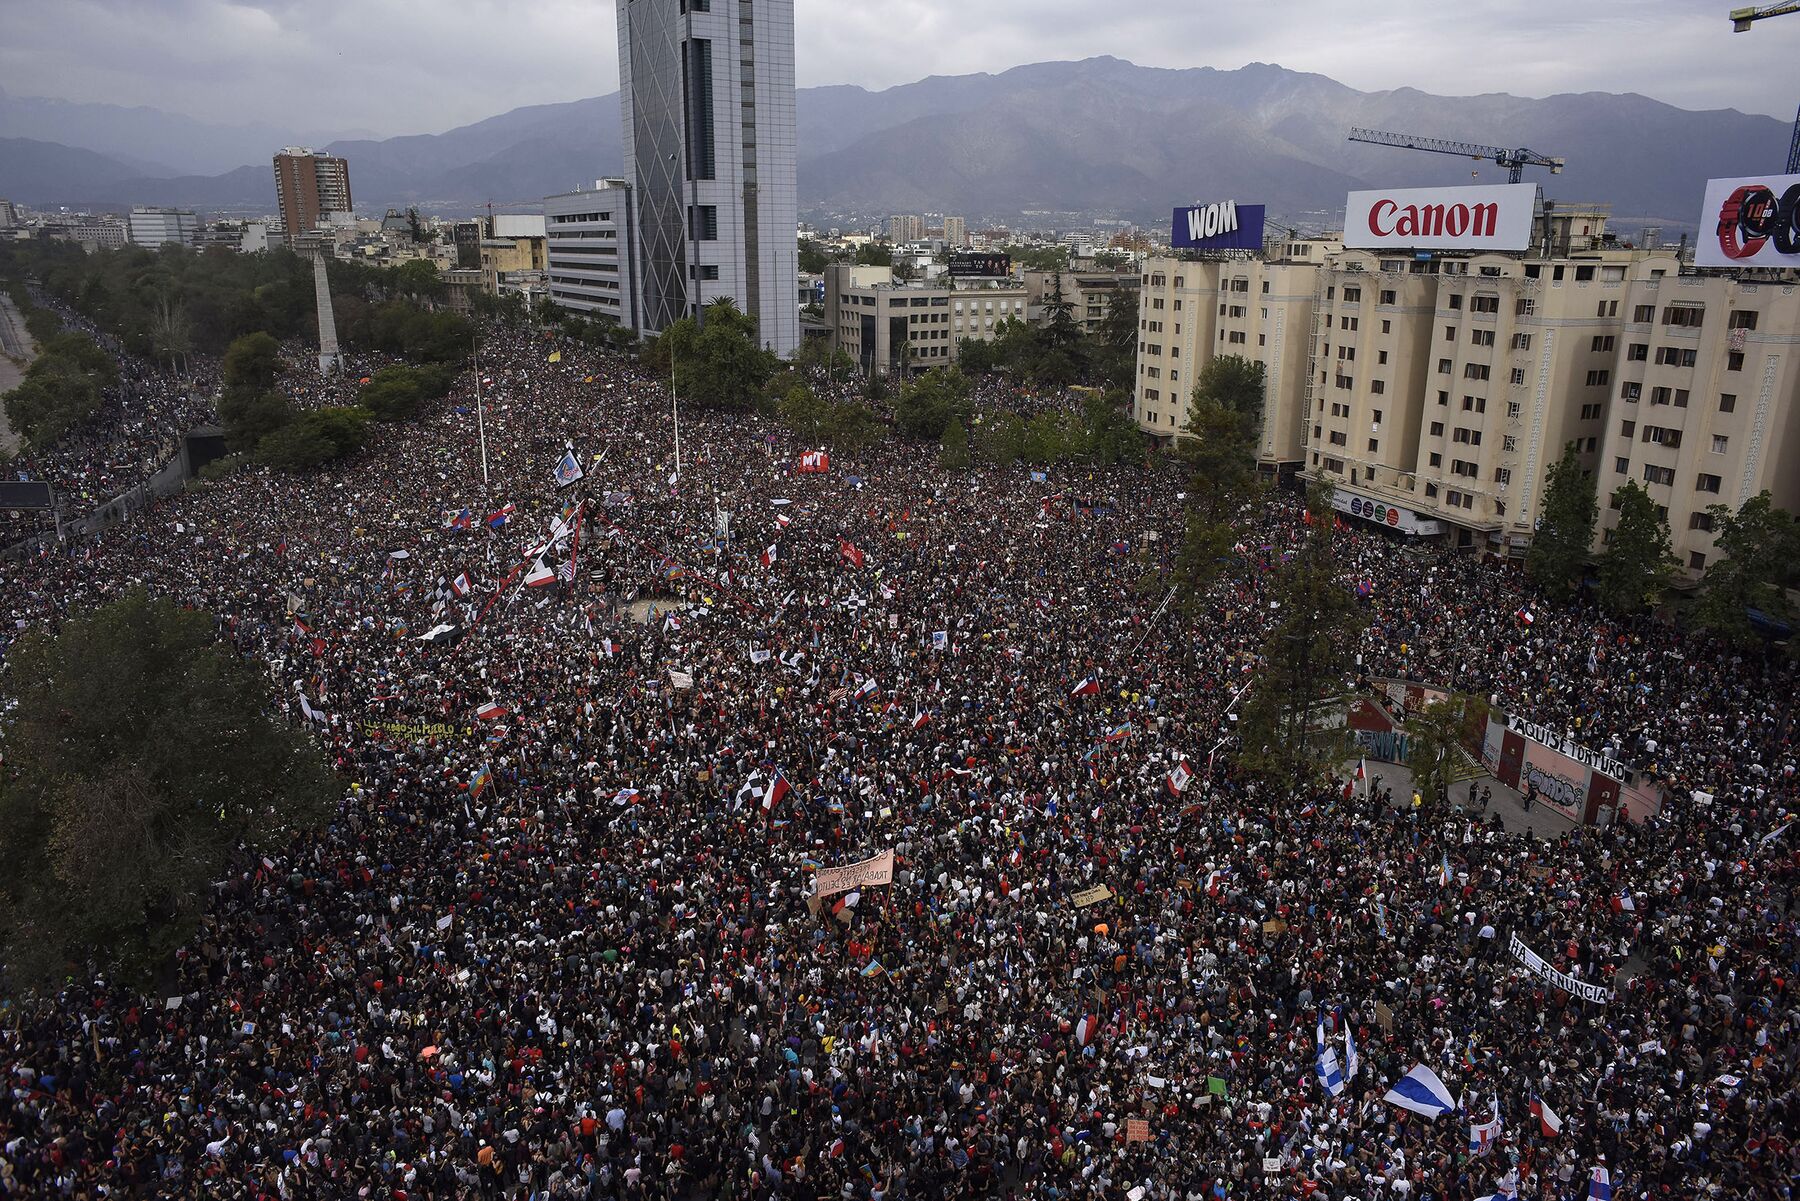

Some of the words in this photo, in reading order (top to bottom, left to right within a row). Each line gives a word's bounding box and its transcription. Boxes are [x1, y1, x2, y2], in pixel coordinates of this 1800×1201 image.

[1187, 200, 1238, 241] WOM
[1368, 199, 1498, 237] Canon
[1570, 740, 1626, 781] TORTURO
[1540, 961, 1607, 1002] RENUNCIA
